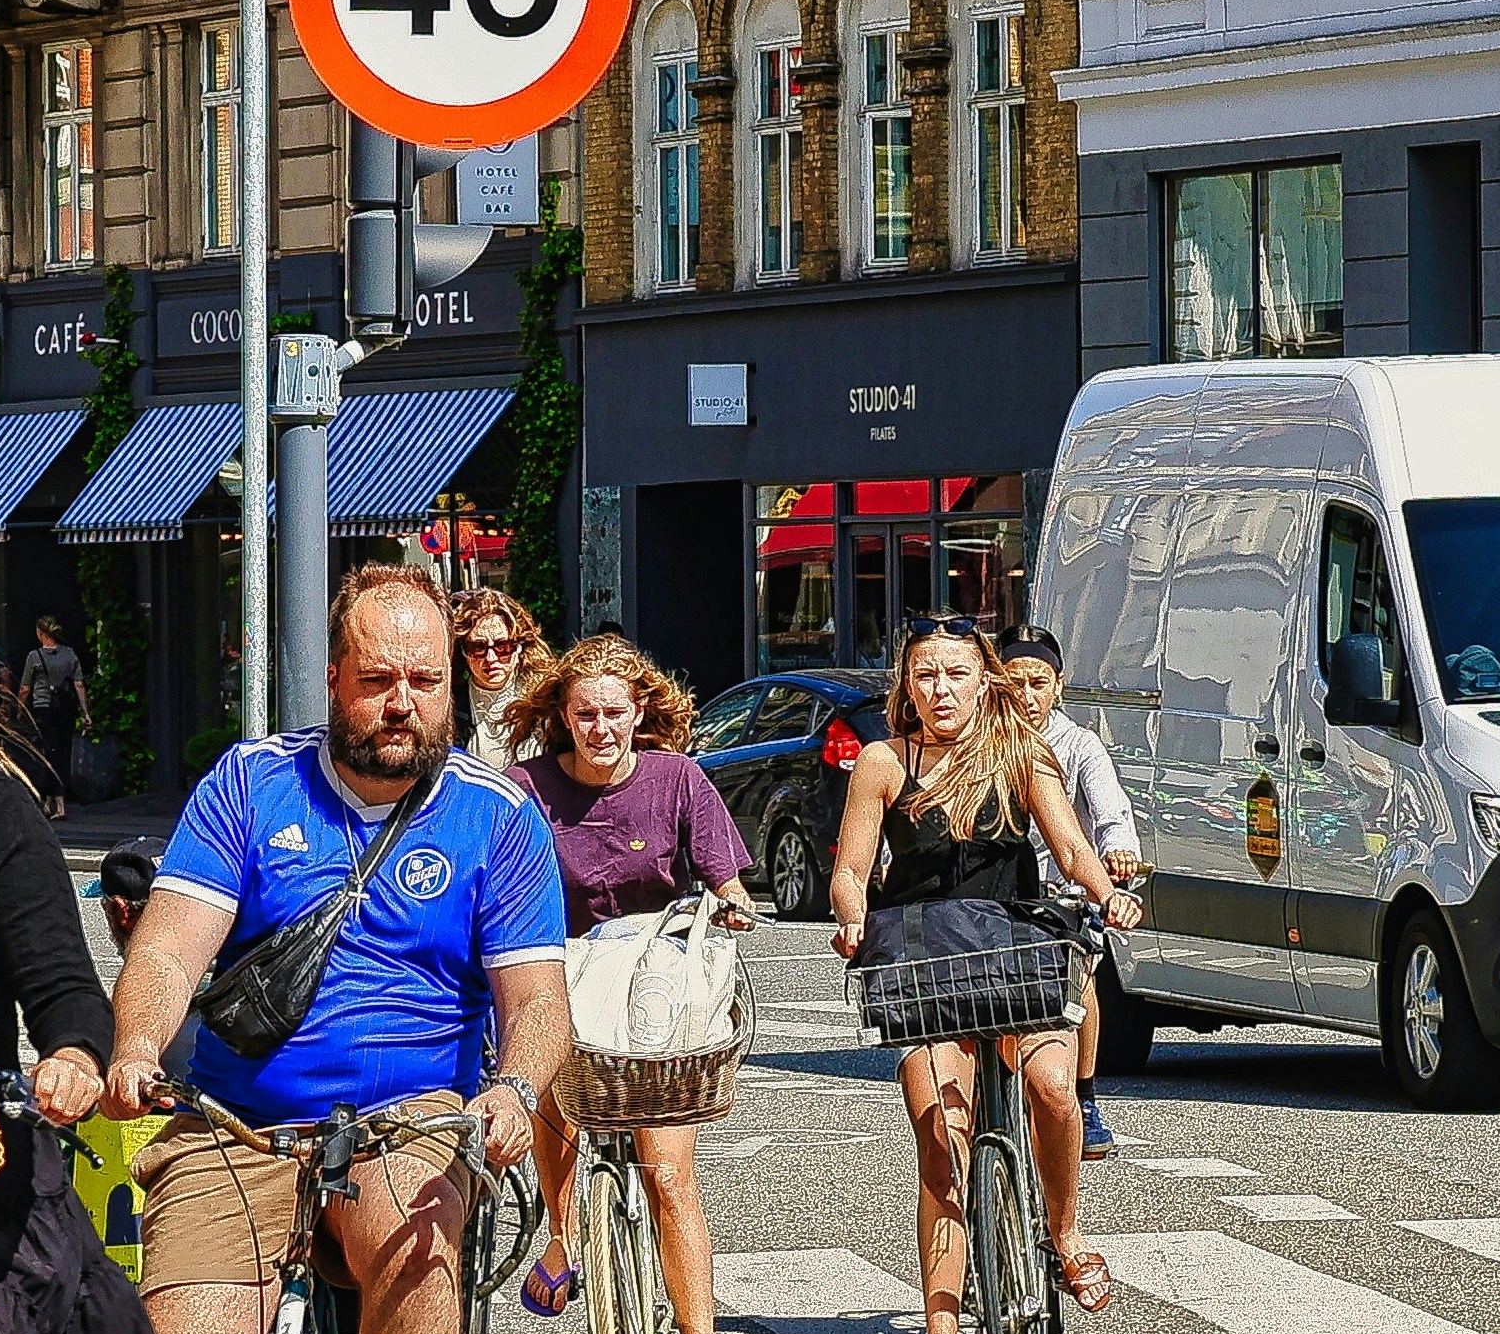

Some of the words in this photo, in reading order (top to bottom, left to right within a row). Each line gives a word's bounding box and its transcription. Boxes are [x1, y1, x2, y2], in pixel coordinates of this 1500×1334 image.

[475, 166, 518, 178] HOTEL
[480, 184, 514, 197] CAFÉ
[484, 204, 512, 215] BAR
[415, 291, 475, 327] OTEL
[34, 313, 86, 355] CAFÉ
[190, 309, 243, 344] COCO
[869, 425, 897, 441] PILATES
